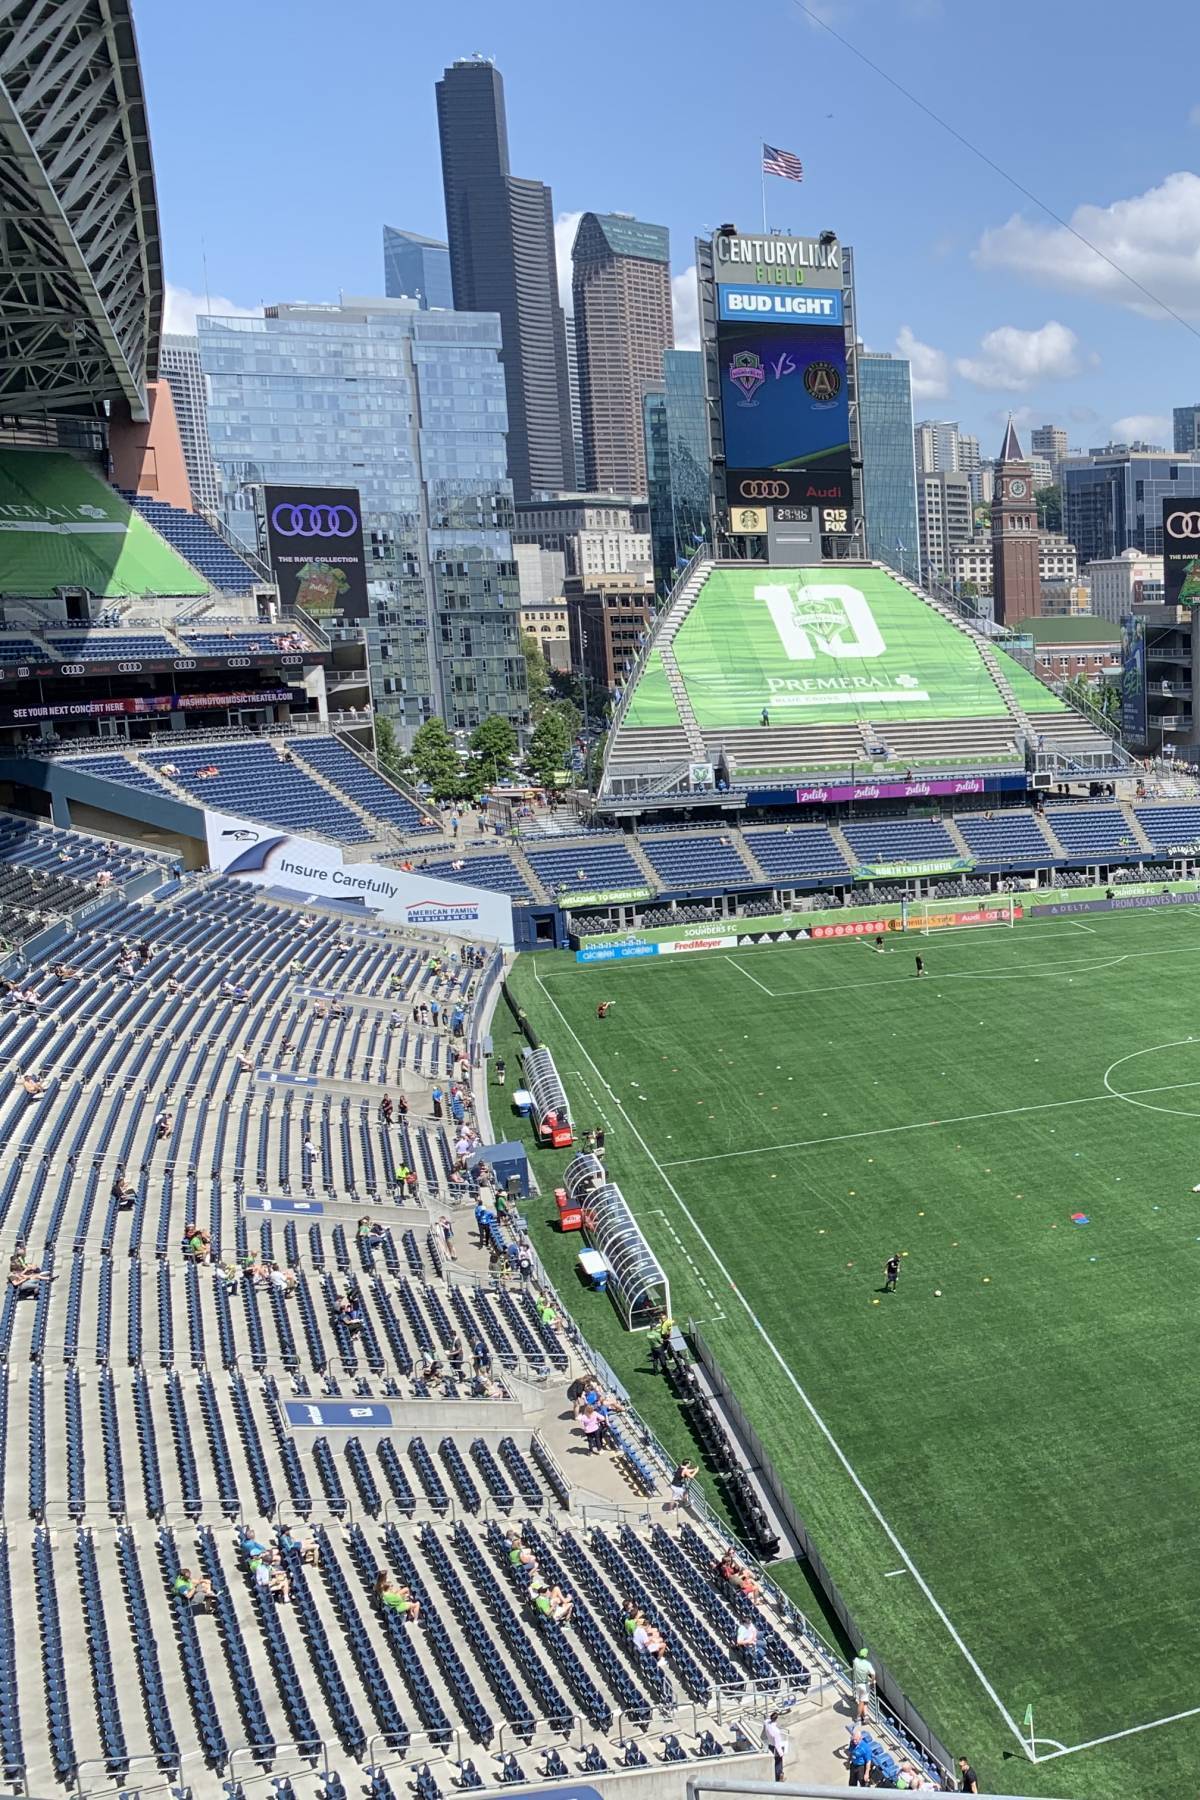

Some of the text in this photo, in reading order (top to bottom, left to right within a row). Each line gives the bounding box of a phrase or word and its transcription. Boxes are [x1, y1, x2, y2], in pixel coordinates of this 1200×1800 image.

[755, 266, 805, 285] FIELD
[728, 293, 833, 315] BUD LIGHT
[771, 353, 796, 379] VS
[805, 486, 841, 498] Audi
[823, 508, 848, 522] Q13
[825, 522, 847, 532] FOX
[766, 675, 884, 693] PREMERA
[13, 708, 28, 718] SEE
[28, 707, 49, 717] YOUR
[49, 706, 69, 715] NEXT
[70, 703, 105, 715] CONCERT
[105, 702, 125, 712] HERE
[919, 861, 953, 872] FAITHFUL
[280, 859, 399, 899] Insure Carefully
[561, 896, 597, 904] WELCOME
[609, 892, 632, 900] GREEN
[1111, 898, 1135, 909] FROM
[1136, 896, 1170, 907] SCARVES
[1183, 894, 1195, 903] TO
[407, 908, 448, 917] AMERICAN
[1060, 903, 1090, 913] DELTA
[412, 914, 475, 922] INSURANCE
[684, 925, 726, 937] SOUNDERS
[727, 924, 738, 932] FC
